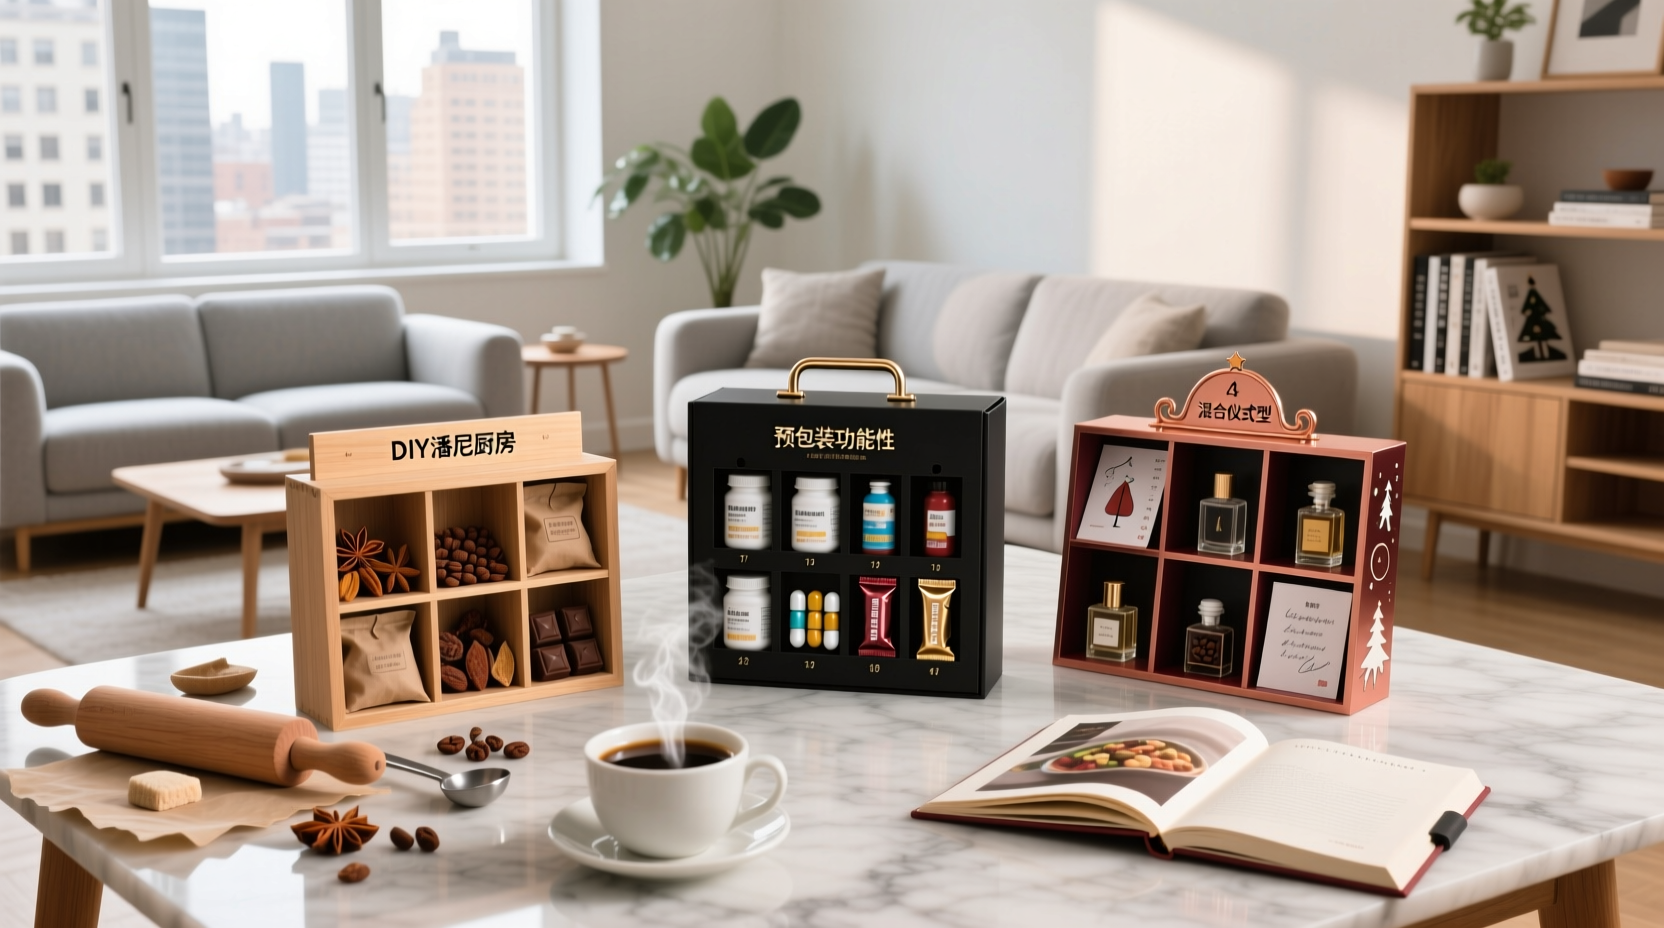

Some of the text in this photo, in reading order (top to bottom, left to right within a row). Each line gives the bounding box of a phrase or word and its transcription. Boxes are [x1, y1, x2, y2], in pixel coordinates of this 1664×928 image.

[1198, 400, 1272, 423] 混合仪式型
[774, 425, 895, 451] 预包装功能性
